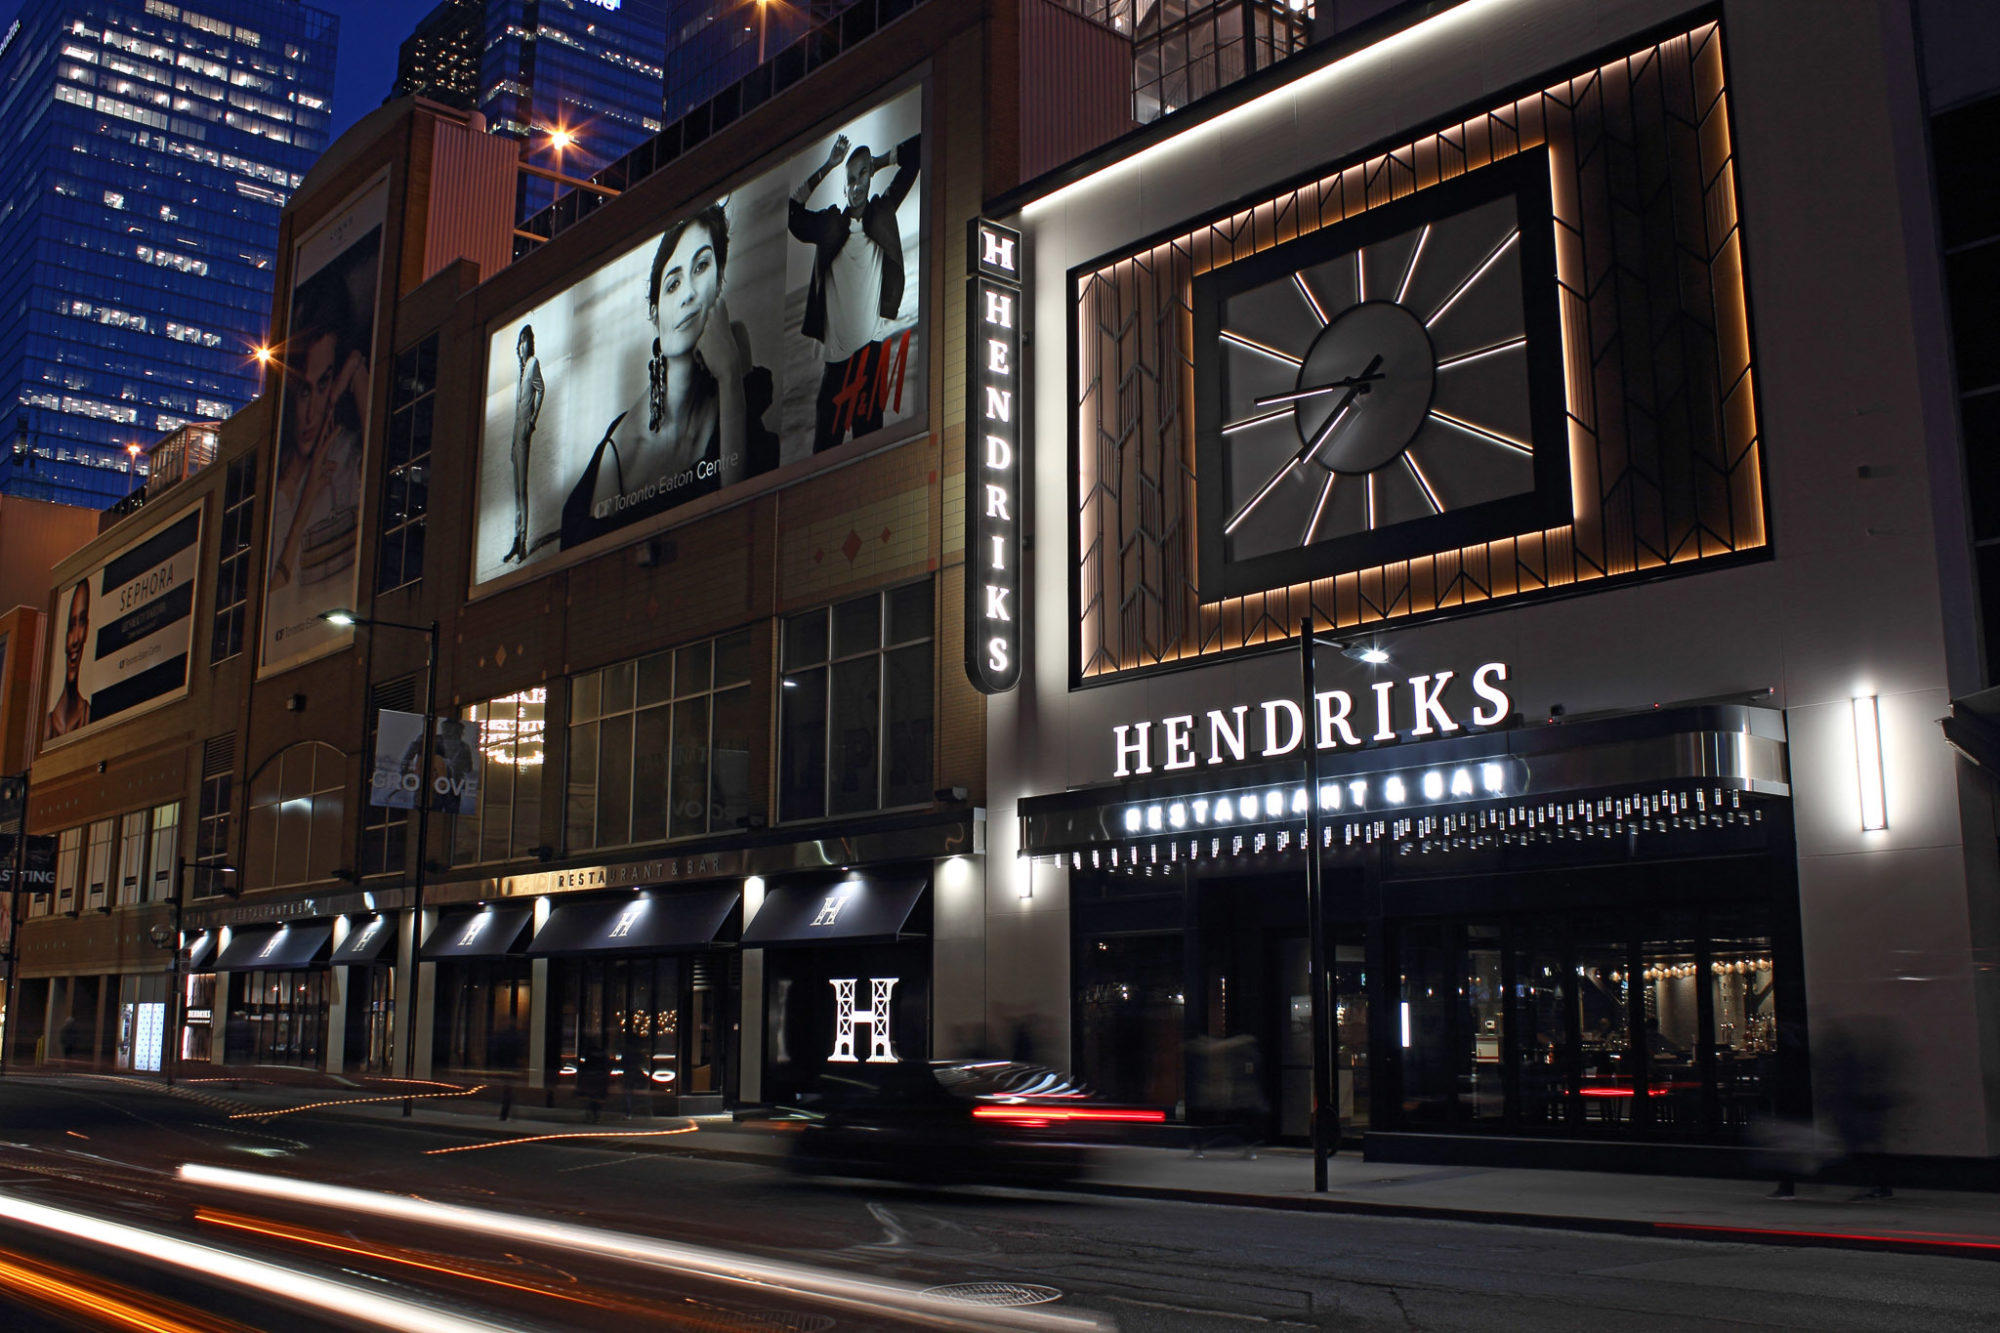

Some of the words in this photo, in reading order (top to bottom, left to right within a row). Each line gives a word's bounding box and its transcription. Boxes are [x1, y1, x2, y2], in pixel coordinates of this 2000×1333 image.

[982, 232, 1014, 271] H
[832, 329, 911, 435] H&M
[614, 485, 656, 512] Toronto
[658, 469, 694, 495] Eaton
[696, 450, 739, 481] Centre
[985, 291, 1011, 673] HENDRIKS
[120, 563, 174, 612] SEPHORA
[1113, 662, 1511, 778] HENDRIKS
[1125, 779, 1368, 832] RESTAURANT
[1423, 762, 1503, 800] BAR
[558, 863, 664, 888] RESTAURANT
[671, 860, 680, 876] &
[687, 856, 722, 875] BAR
[827, 977, 900, 1064] H
